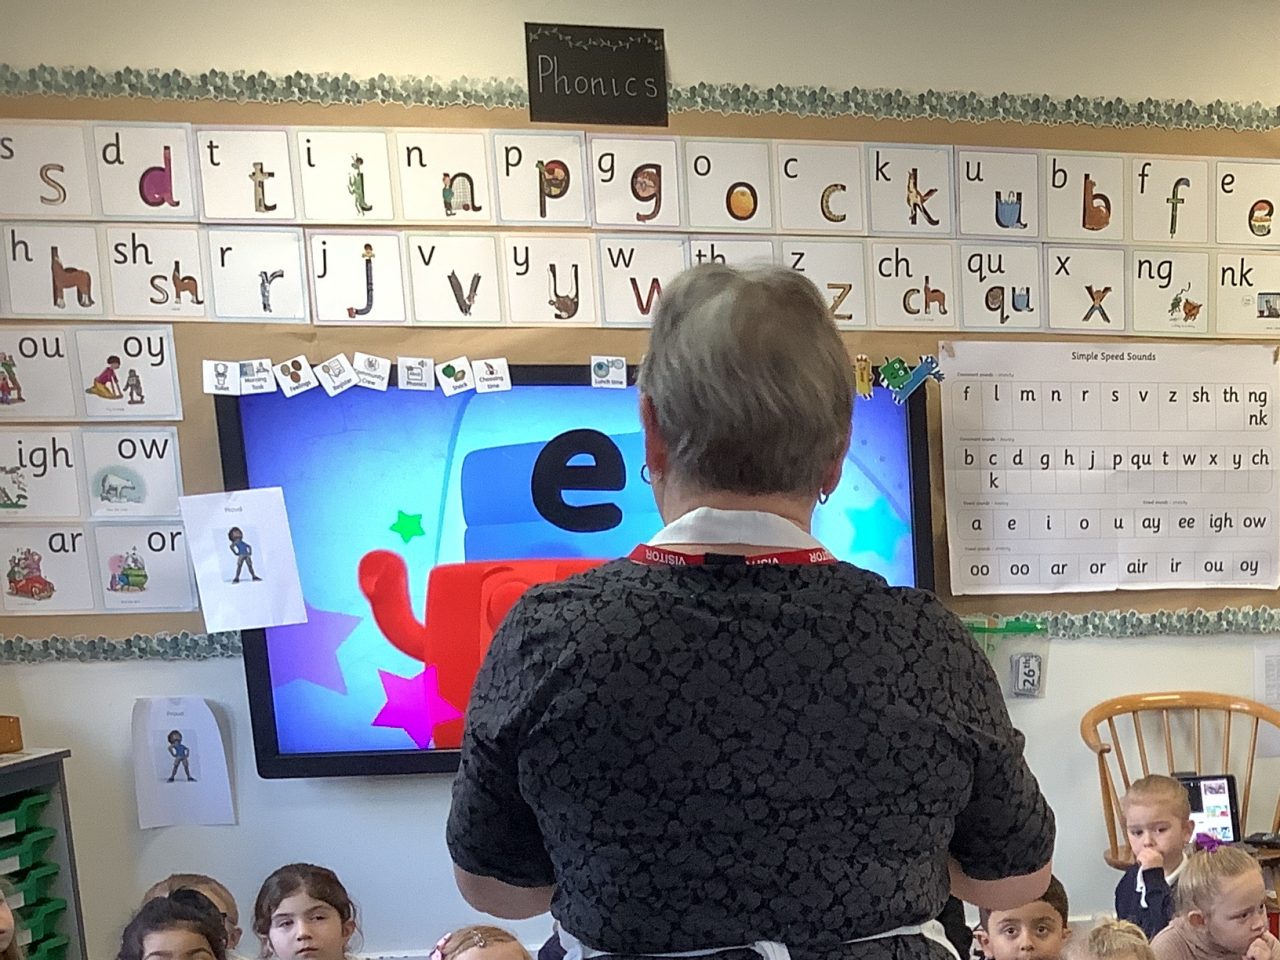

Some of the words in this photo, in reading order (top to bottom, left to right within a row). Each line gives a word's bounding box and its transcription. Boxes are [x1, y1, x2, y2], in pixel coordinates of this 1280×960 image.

[538, 54, 658, 97] Phonics
[0, 137, 15, 160] s
[102, 132, 125, 165] d
[206, 140, 221, 167] t
[305, 138, 316, 168] i
[406, 146, 427, 168] n
[504, 146, 523, 177] p
[597, 152, 615, 183] g
[693, 155, 711, 177] o
[783, 157, 798, 179] c
[875, 150, 892, 182] k
[967, 162, 983, 181] u
[1051, 157, 1068, 189] b
[1138, 162, 1152, 194] f
[1221, 174, 1234, 193] e
[10, 228, 34, 262] h
[113, 232, 153, 265] sh
[418, 246, 435, 265] v
[220, 246, 233, 268] r
[317, 240, 327, 279] j
[513, 246, 530, 276] y
[608, 248, 634, 267] w
[792, 252, 805, 271] z
[878, 247, 913, 278] ch
[967, 253, 1006, 283] qu
[1056, 256, 1070, 275] x
[1137, 259, 1173, 289] ng
[1221, 257, 1254, 287] nk
[18, 336, 65, 359] ou
[123, 336, 165, 367] oy
[1072, 352, 1098, 362] Simple
[1101, 352, 1124, 362] Speed
[964, 386, 970, 400] f
[995, 385, 999, 401] l
[1021, 390, 1036, 401] m
[1052, 390, 1061, 401] n
[1082, 390, 1089, 401] r
[1112, 391, 1118, 401] s
[1139, 391, 1148, 401] v
[1169, 391, 1176, 402] z
[1193, 386, 1210, 402] sh
[1224, 387, 1239, 402] th
[1249, 392, 1267, 407] ng
[1250, 410, 1267, 425] nk
[17, 437, 73, 478] igh
[117, 438, 169, 460] ow
[965, 449, 973, 465] b
[989, 454, 997, 465] c
[1013, 449, 1023, 465] d
[1041, 454, 1049, 470] g
[1065, 449, 1074, 465] h
[1088, 451, 1094, 470] j
[1113, 455, 1122, 470] p
[1131, 455, 1151, 469] qu
[1163, 452, 1168, 465] t
[1183, 455, 1196, 465] w
[1210, 454, 1217, 464] x
[1233, 455, 1241, 469] y
[1252, 449, 1269, 465] ch
[531, 428, 626, 533] e
[990, 472, 998, 488] k
[972, 520, 981, 530] a
[1008, 519, 1016, 530] e
[1047, 516, 1051, 529] i
[1080, 519, 1089, 529] o
[1115, 518, 1123, 529] u
[1143, 518, 1160, 533] ay
[1179, 518, 1195, 528] ee
[1210, 513, 1233, 532] igh
[1244, 517, 1266, 527] ow
[49, 533, 82, 552] ar
[147, 531, 182, 553] or
[645, 549, 686, 565] VISITOR
[971, 565, 989, 576] oo
[1011, 564, 1029, 575] oo
[1051, 564, 1067, 574] ar
[1090, 563, 1106, 573] or
[1127, 559, 1148, 573] air
[1171, 558, 1181, 572] ir
[1205, 562, 1223, 572] ou
[1241, 561, 1258, 576] oy
[1022, 655, 1036, 687] 26th
